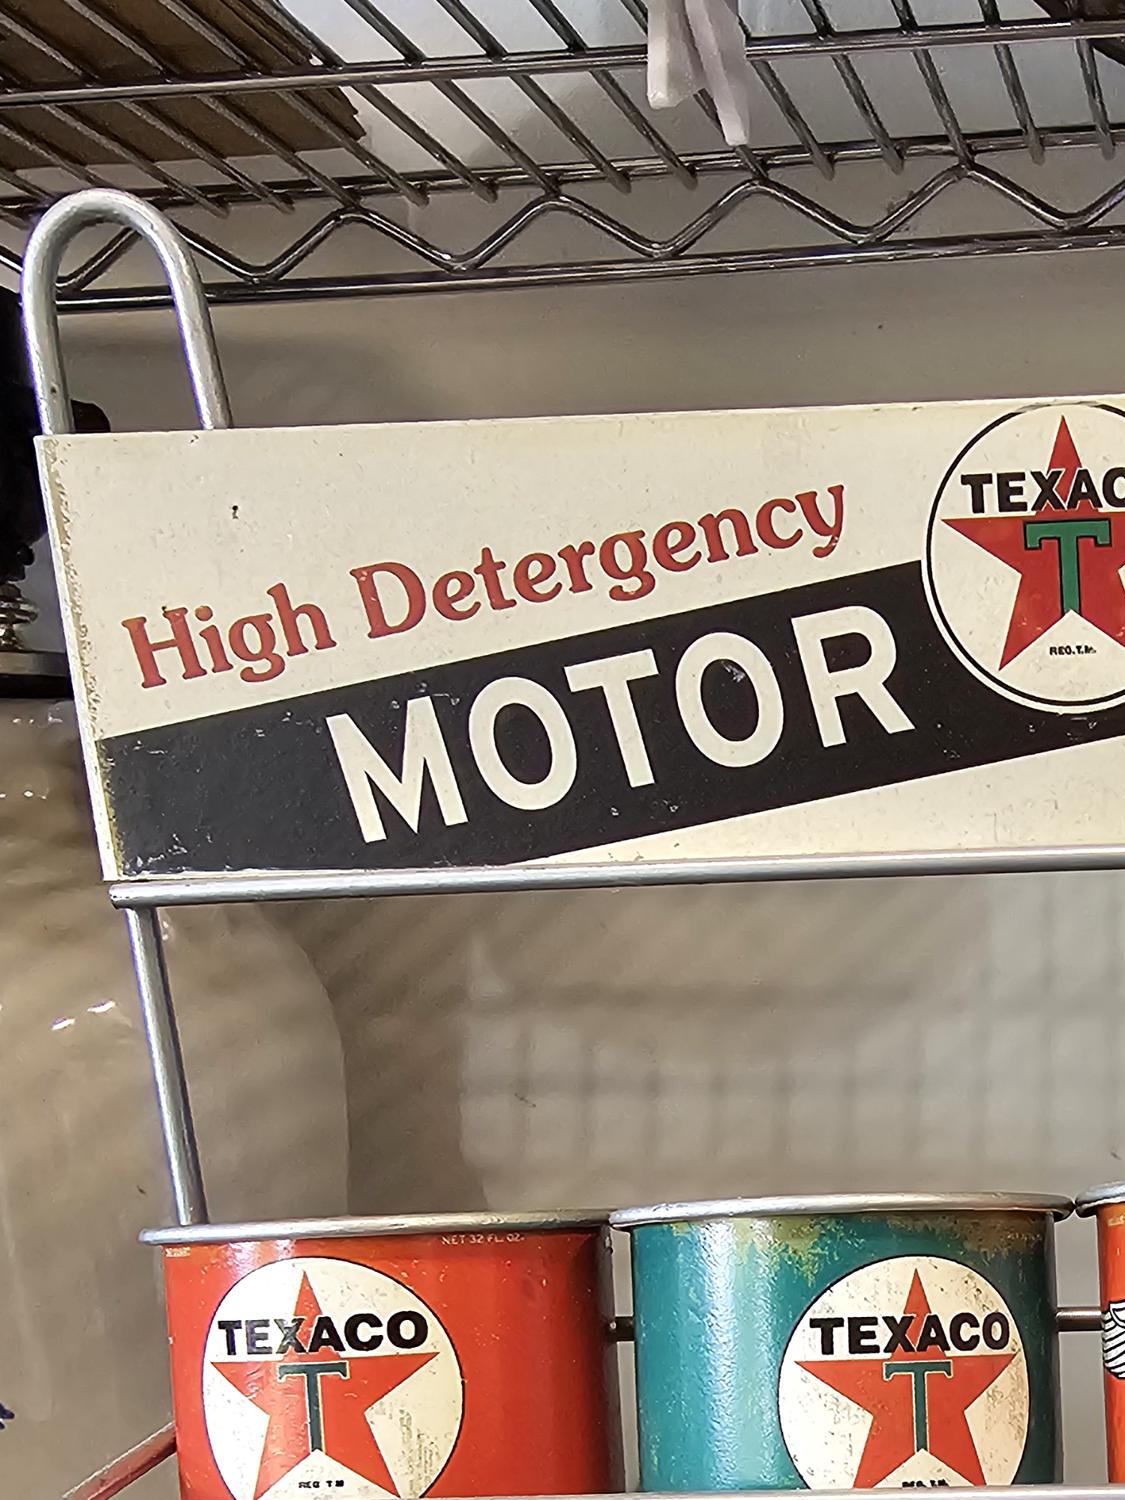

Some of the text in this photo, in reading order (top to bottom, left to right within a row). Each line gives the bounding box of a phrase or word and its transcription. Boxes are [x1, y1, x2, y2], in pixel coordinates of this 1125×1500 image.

[121, 483, 848, 690] High Detergency
[1023, 518, 1113, 617] T
[325, 604, 915, 844] MOTOR
[441, 1234, 466, 1245] NET
[469, 1233, 485, 1243] 32
[217, 1309, 428, 1357] TEXACO
[809, 1311, 1010, 1356] TEXACO
[278, 1360, 351, 1451] T
[882, 1359, 955, 1453] T
